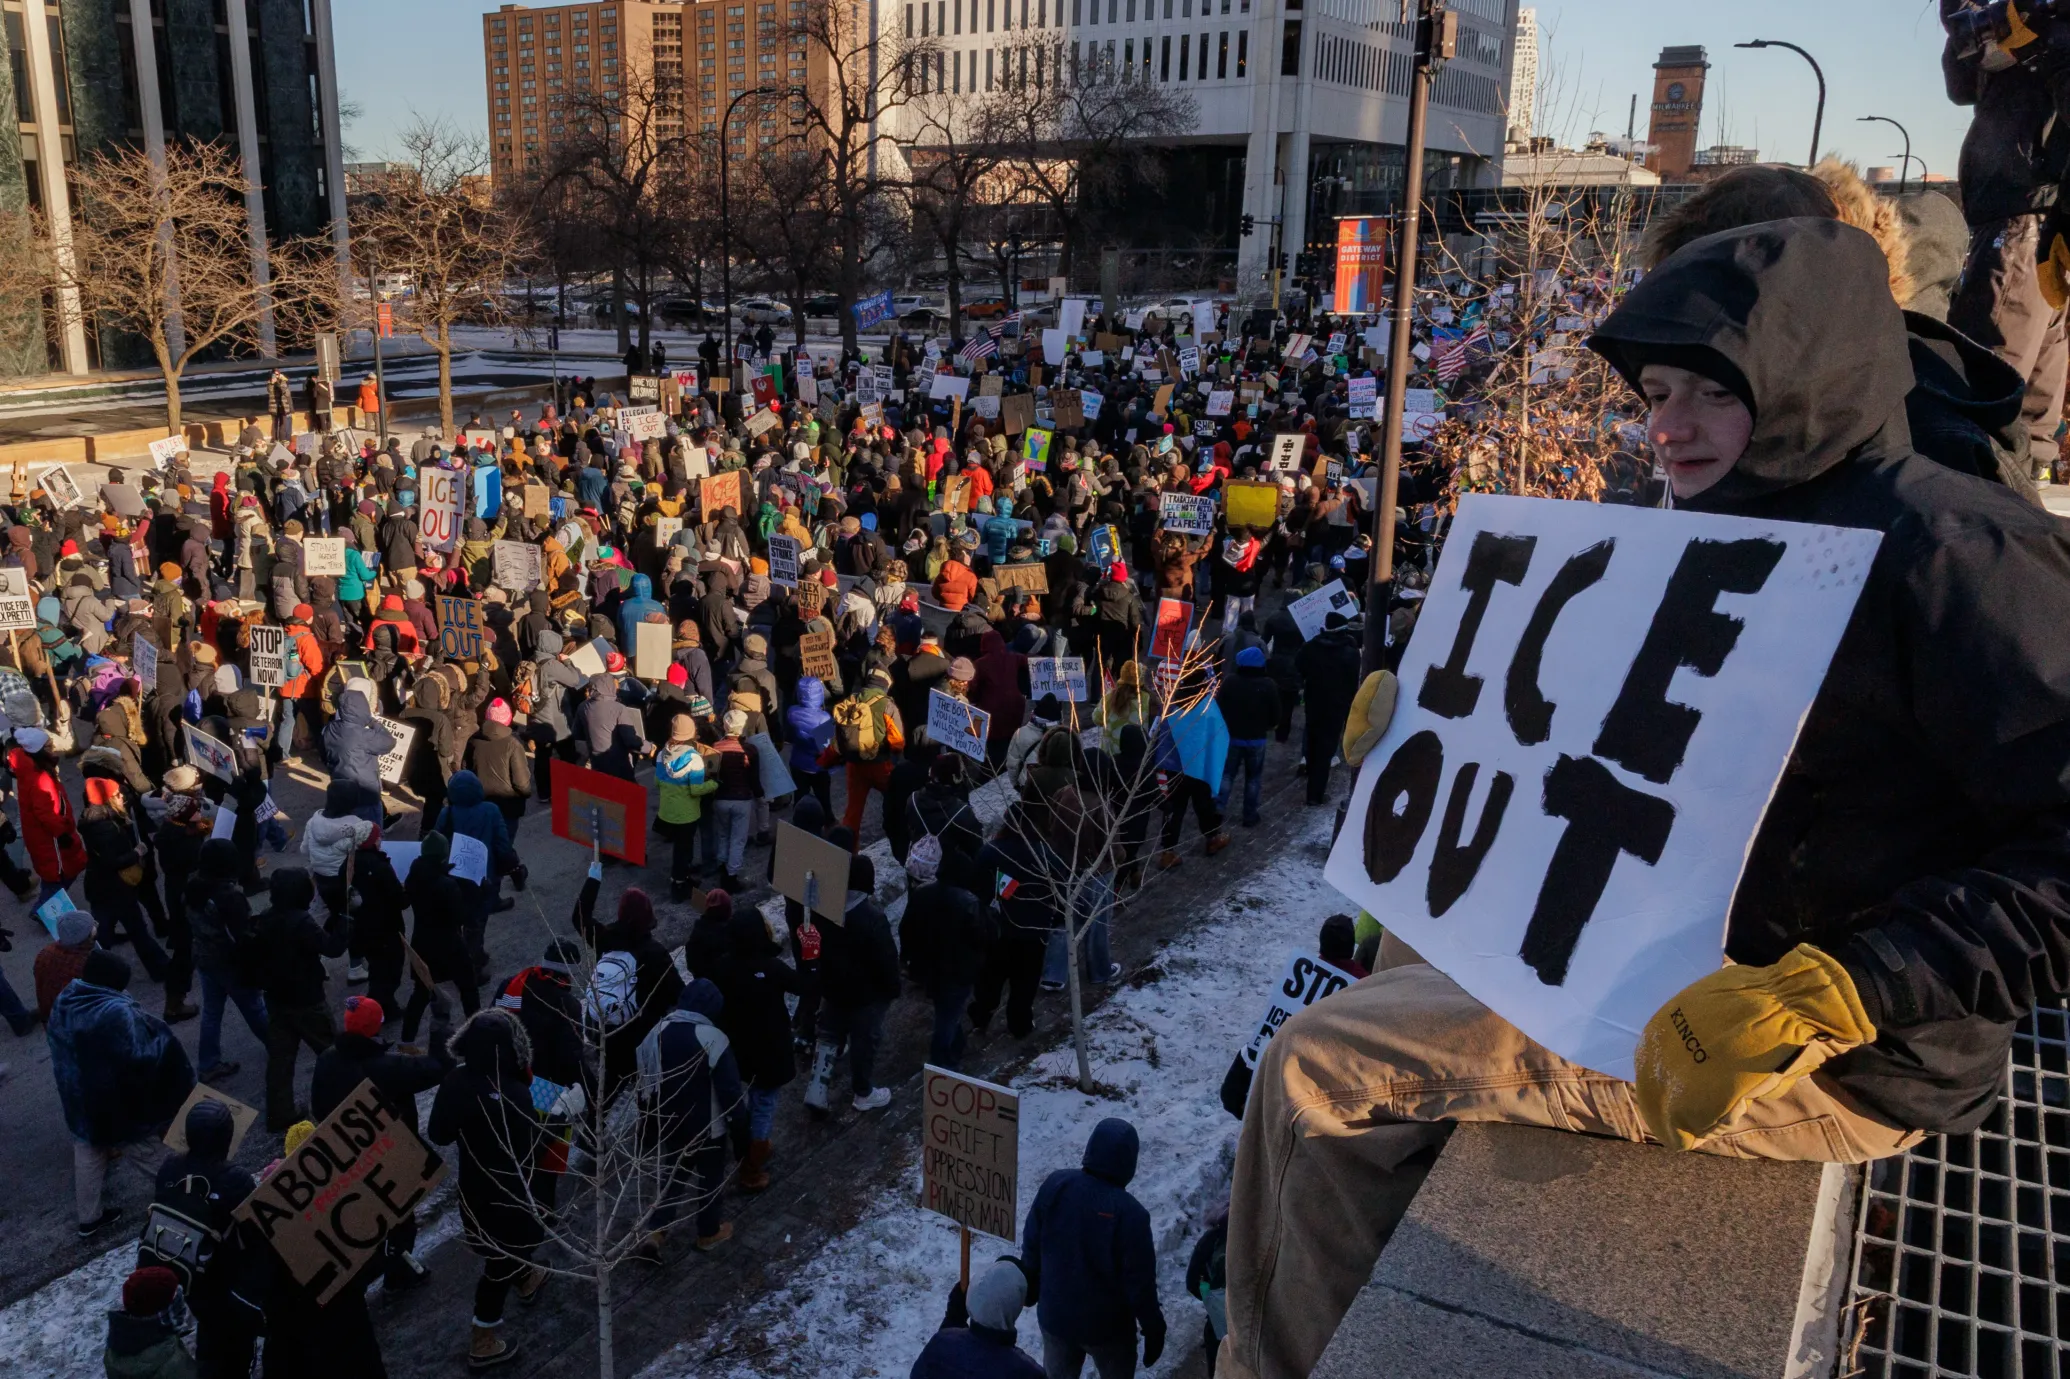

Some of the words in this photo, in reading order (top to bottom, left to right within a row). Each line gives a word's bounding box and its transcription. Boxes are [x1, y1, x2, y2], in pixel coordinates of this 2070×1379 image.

[1652, 102, 1694, 110] MILWAUKEE
[632, 378, 645, 386] HAVE
[645, 379, 658, 387] YOU
[632, 387, 640, 396] NO
[640, 388, 658, 397] SHAME?
[621, 408, 648, 418] ILLEGAL
[637, 415, 658, 425] ICE
[429, 475, 458, 505] ICE
[1168, 495, 1197, 504] TRABAJAR
[1199, 498, 1211, 506] PARA
[423, 508, 463, 541] OUT
[310, 543, 337, 551] STAND
[770, 537, 793, 549] GENERAL
[773, 569, 796, 582] JUSTICE
[798, 581, 819, 593] ALEX
[15, 601, 30, 610] FOR
[800, 600, 818, 610] WAS
[7, 610, 32, 621] PRETTI
[442, 598, 479, 629] ICE
[1159, 615, 1184, 626] STOP
[252, 628, 282, 654] STOP
[442, 627, 482, 662] OUT
[252, 656, 260, 667] ICE
[261, 656, 283, 669] TERROR
[1417, 530, 1788, 786] ICE
[805, 664, 833, 678] RACISTS
[1032, 662, 1042, 673] MY
[1043, 661, 1078, 672] NEIGHBORS
[257, 669, 277, 684] NOW!
[1049, 672, 1068, 680] FIGHT
[1032, 681, 1038, 689] IS
[1041, 681, 1051, 691] MY
[1053, 680, 1070, 690] FIGHT
[1073, 680, 1084, 688] TOO
[936, 696, 950, 711] THE
[951, 704, 973, 720] BOOT
[936, 709, 948, 720] YOU
[932, 717, 948, 731] WILL
[955, 739, 968, 750] YOU
[968, 740, 982, 755] TOO
[1362, 729, 1677, 987] OUT
[1671, 1007, 1707, 1064] KINCO
[930, 1113, 1004, 1162] GRIFT
[250, 1086, 399, 1239] ABOLISH
[925, 1146, 1011, 1204] OPPRESSION
[930, 1180, 976, 1227] POWER
[979, 1202, 1010, 1238] MAD
[314, 1162, 427, 1271] ICE
